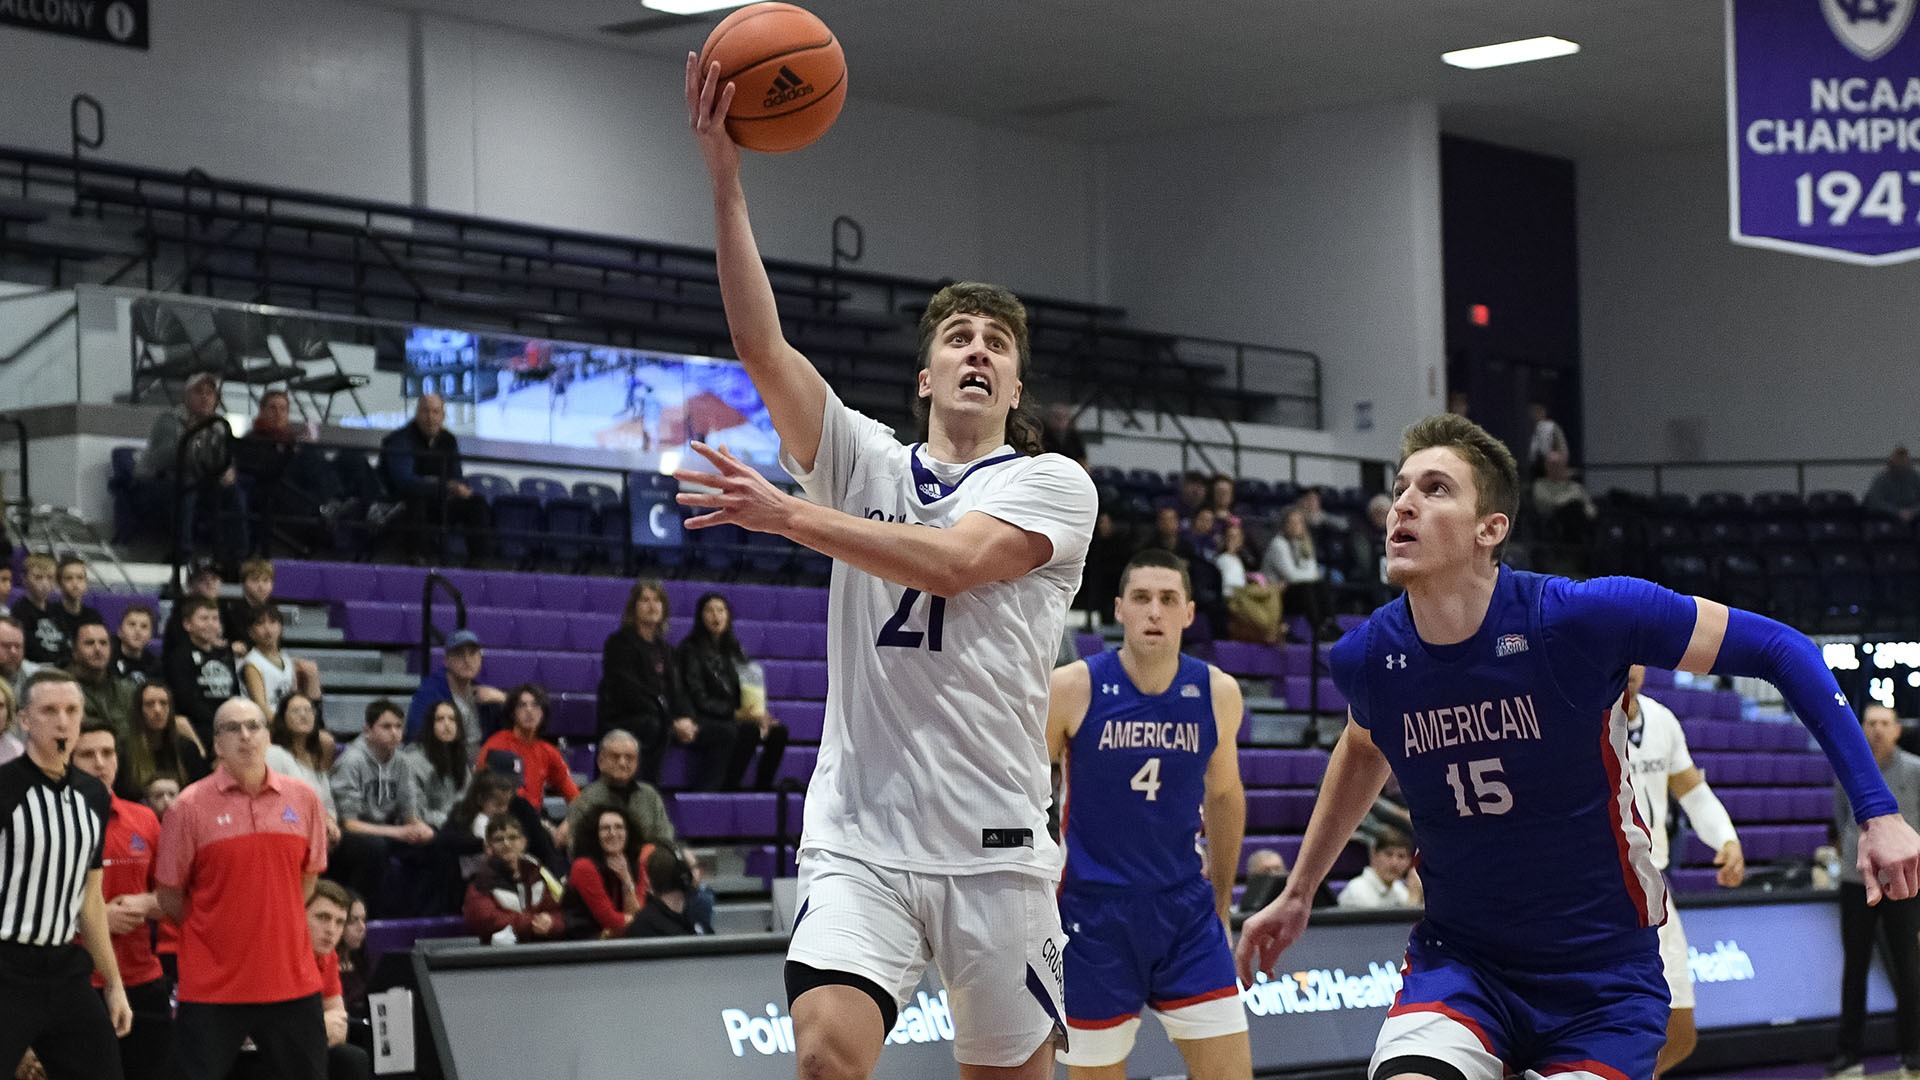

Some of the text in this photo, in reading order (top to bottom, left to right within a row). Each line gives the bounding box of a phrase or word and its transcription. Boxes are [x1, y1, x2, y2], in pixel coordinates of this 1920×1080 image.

[763, 84, 814, 108] adidas
[1810, 77, 1920, 113] NCAA
[649, 503, 667, 538] C
[876, 587, 946, 652] 21
[1098, 720, 1199, 754] AMERICAN
[1403, 695, 1541, 758] AMERICAN
[1130, 758, 1162, 801] 4
[1446, 758, 1514, 816] 15
